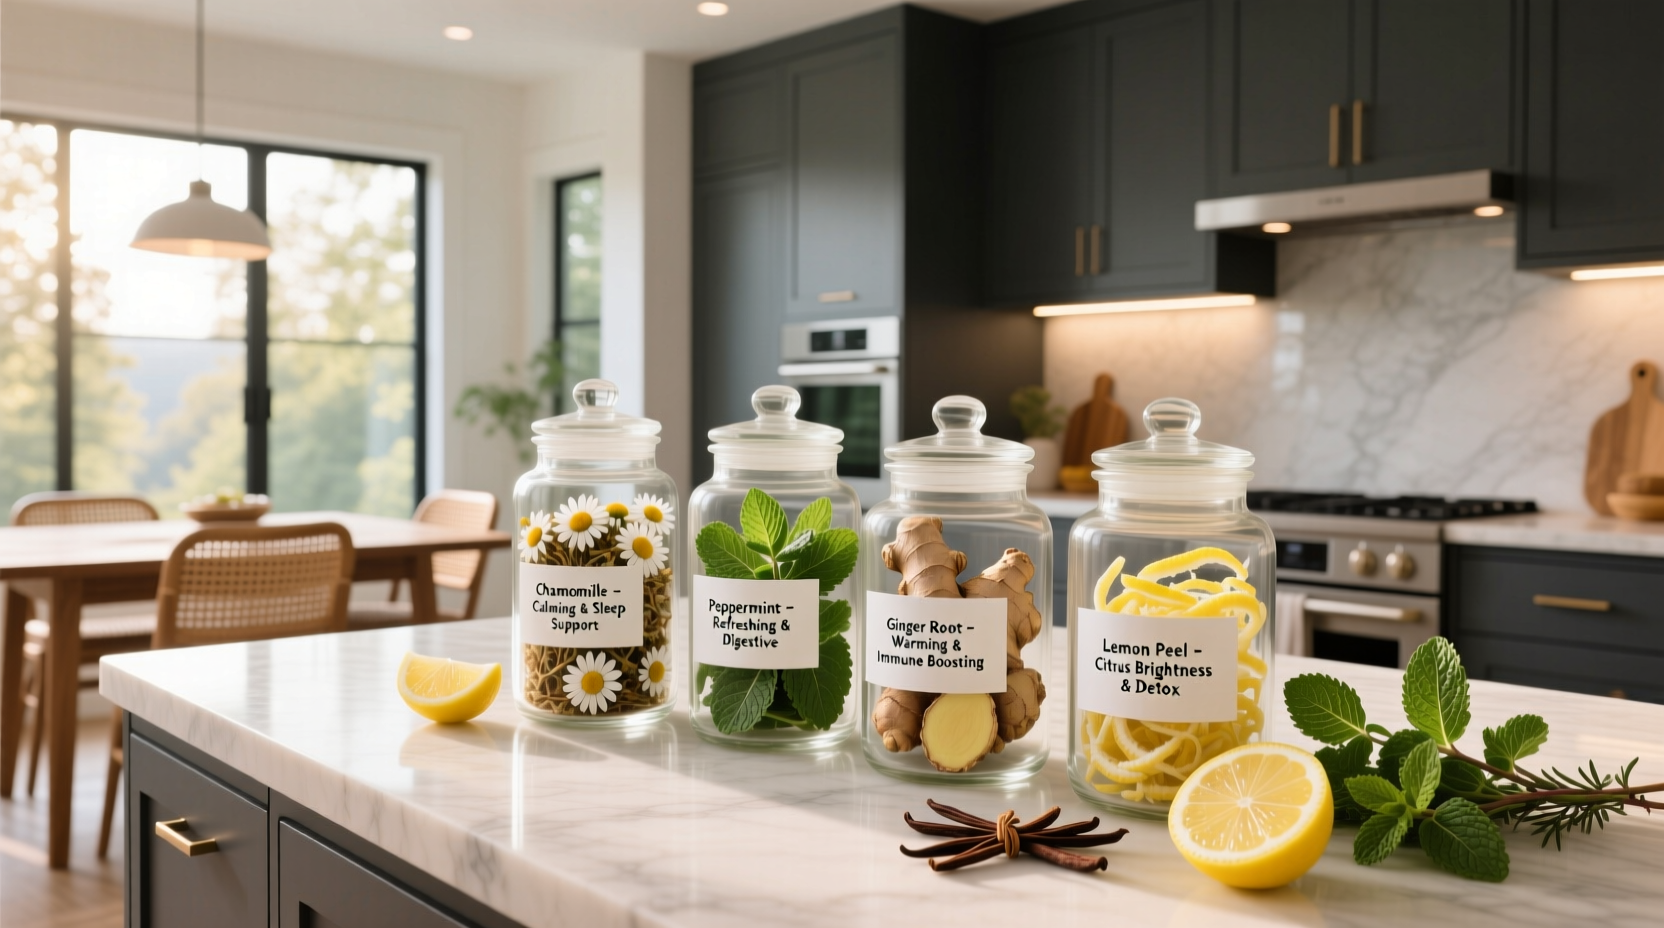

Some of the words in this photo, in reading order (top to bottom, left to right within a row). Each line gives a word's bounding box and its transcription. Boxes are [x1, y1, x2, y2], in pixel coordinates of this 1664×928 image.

[535, 582, 608, 598] Chamomille
[532, 600, 577, 619] Calming
[580, 602, 589, 615] &
[592, 601, 626, 619] Sleep
[708, 598, 782, 617] Peppermint
[551, 617, 599, 635] Support
[713, 614, 777, 635] Refreshing
[780, 618, 791, 631] &
[886, 617, 927, 637] Ginger
[929, 620, 963, 634] Root
[722, 633, 779, 651] Digestive
[891, 634, 948, 655] Warming
[952, 638, 962, 652] &
[1103, 637, 1151, 657] Lemon
[1155, 641, 1188, 658] Peel
[877, 650, 924, 667] Immune
[927, 654, 985, 672] Boosting
[1094, 656, 1131, 674] Citrus
[1135, 659, 1213, 681] Brightness
[1120, 678, 1132, 693] &
[1135, 678, 1181, 697] Detox
